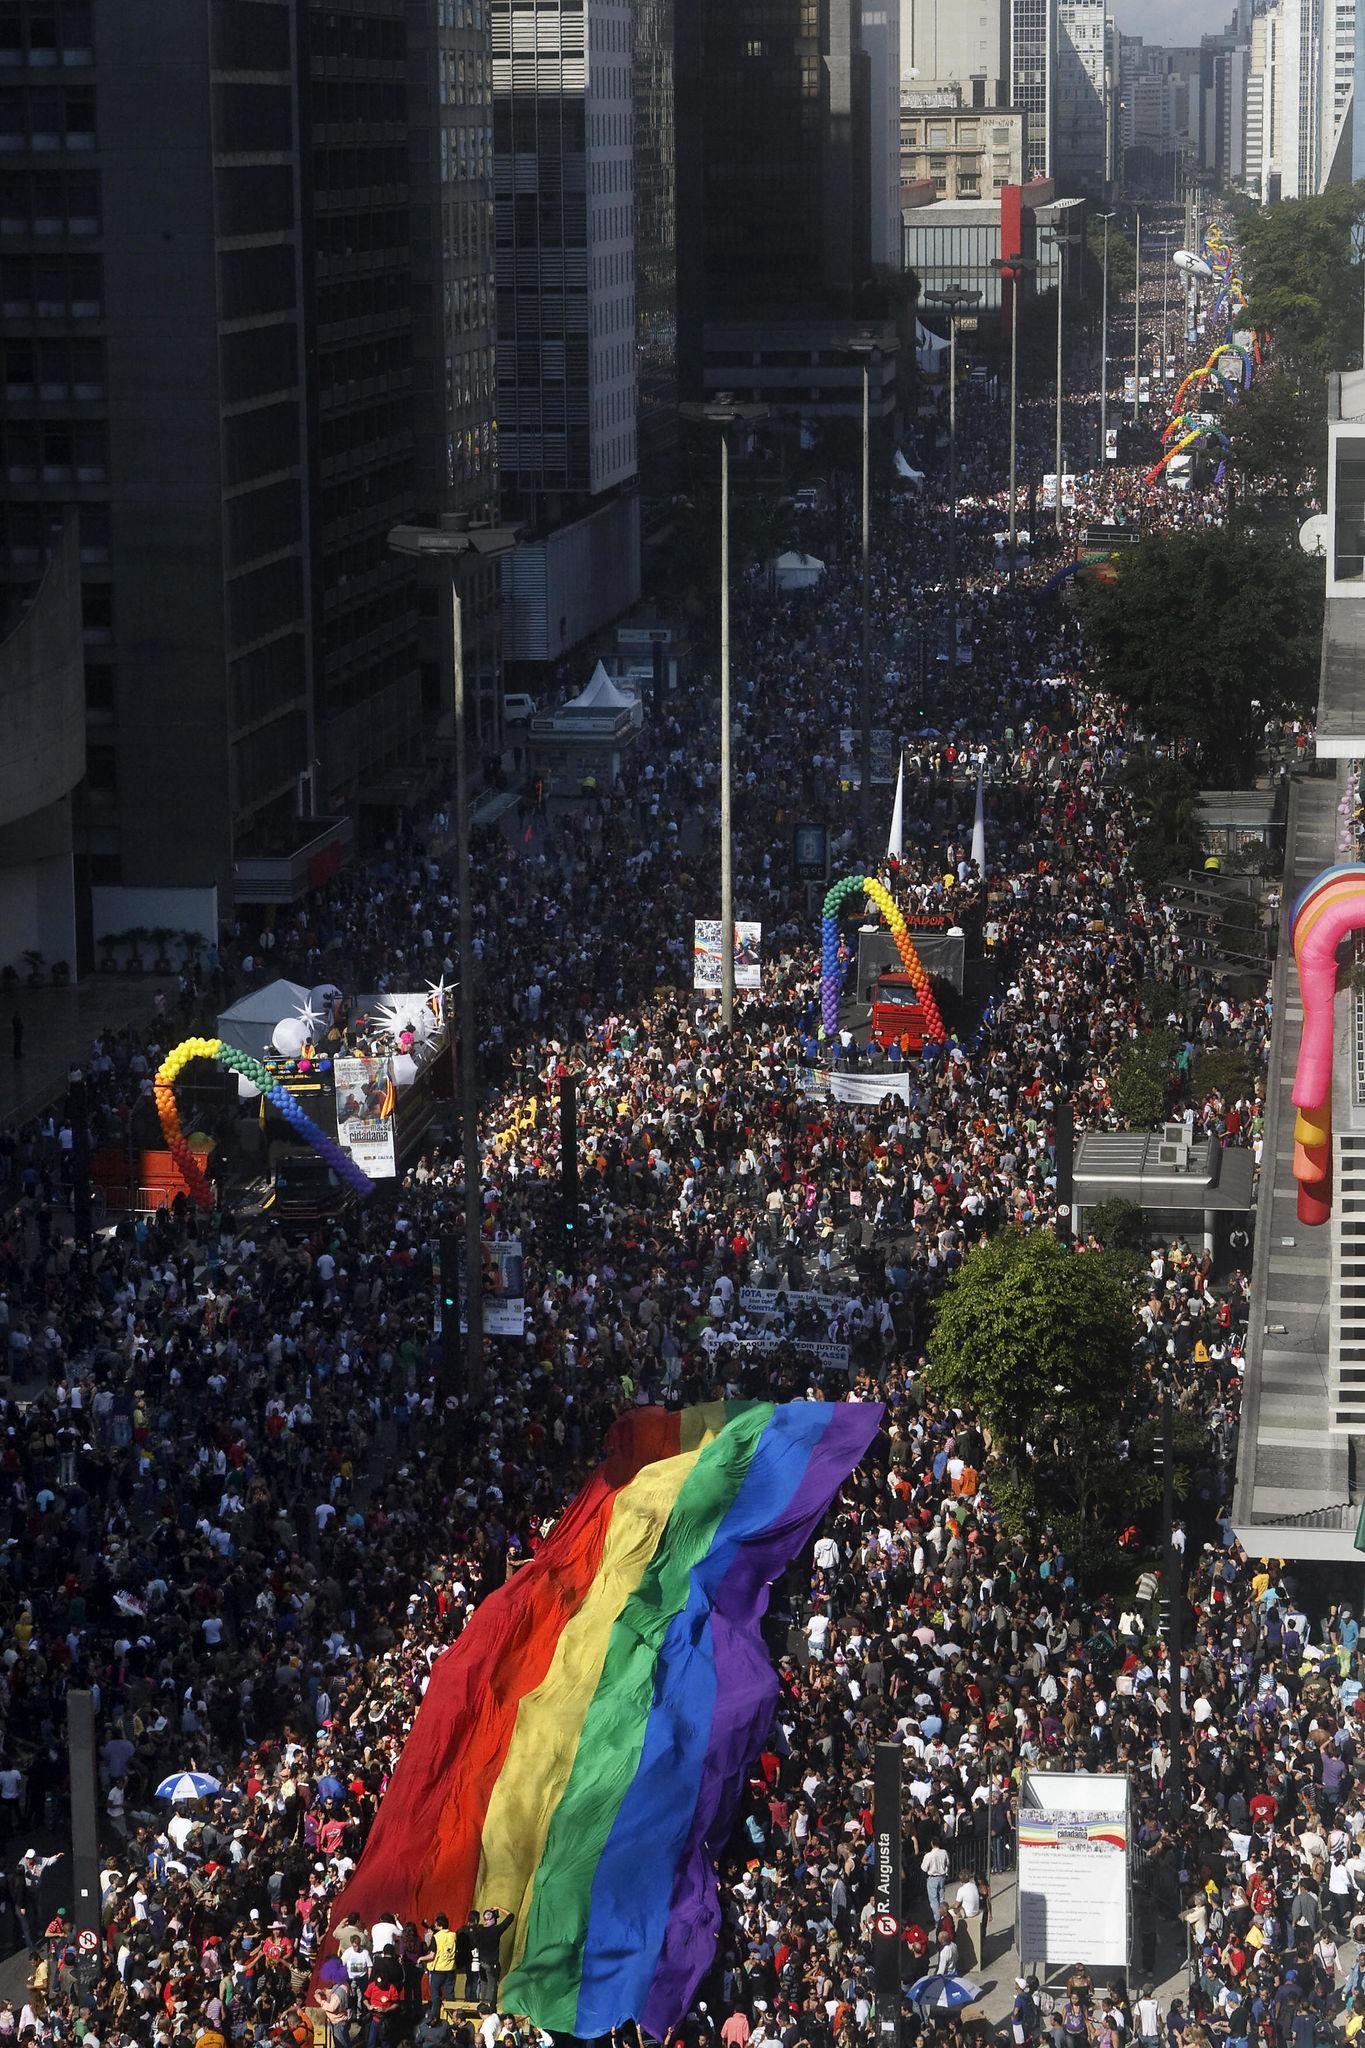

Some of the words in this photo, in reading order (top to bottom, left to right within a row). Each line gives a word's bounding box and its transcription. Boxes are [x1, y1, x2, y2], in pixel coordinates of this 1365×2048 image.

[349, 1131, 389, 1144] cidadania
[816, 1344, 847, 1353] JUSTIÇA
[877, 1833, 892, 1895] Augusta
[877, 1899, 890, 1914] R.
